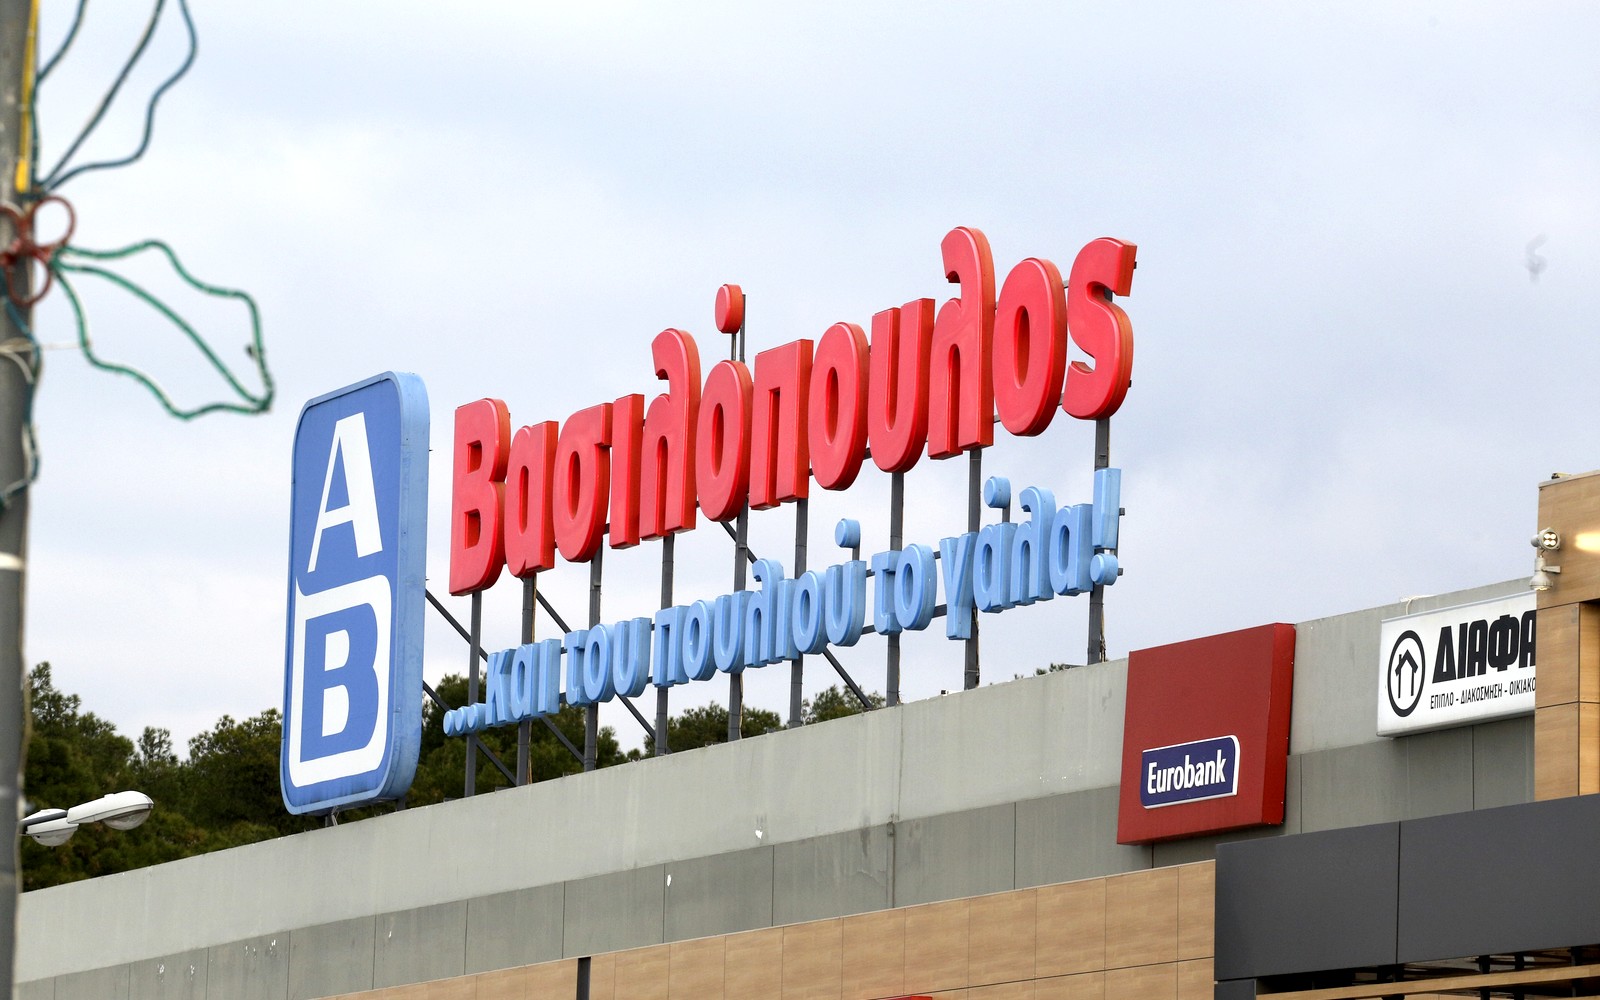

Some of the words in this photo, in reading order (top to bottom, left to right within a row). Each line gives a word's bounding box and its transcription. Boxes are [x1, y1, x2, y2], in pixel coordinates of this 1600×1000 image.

[449, 227, 1137, 596] Βασιλόπουλος
[565, 617, 652, 706] του
[872, 543, 938, 635] το
[939, 468, 1121, 639] γάλα!
[1430, 692, 1454, 709] ΕΠΙΠΛΟ
[1460, 683, 1503, 704] ΔΙΑΚΟΣΜΗΣΗ
[1147, 749, 1227, 794] Eurobank
